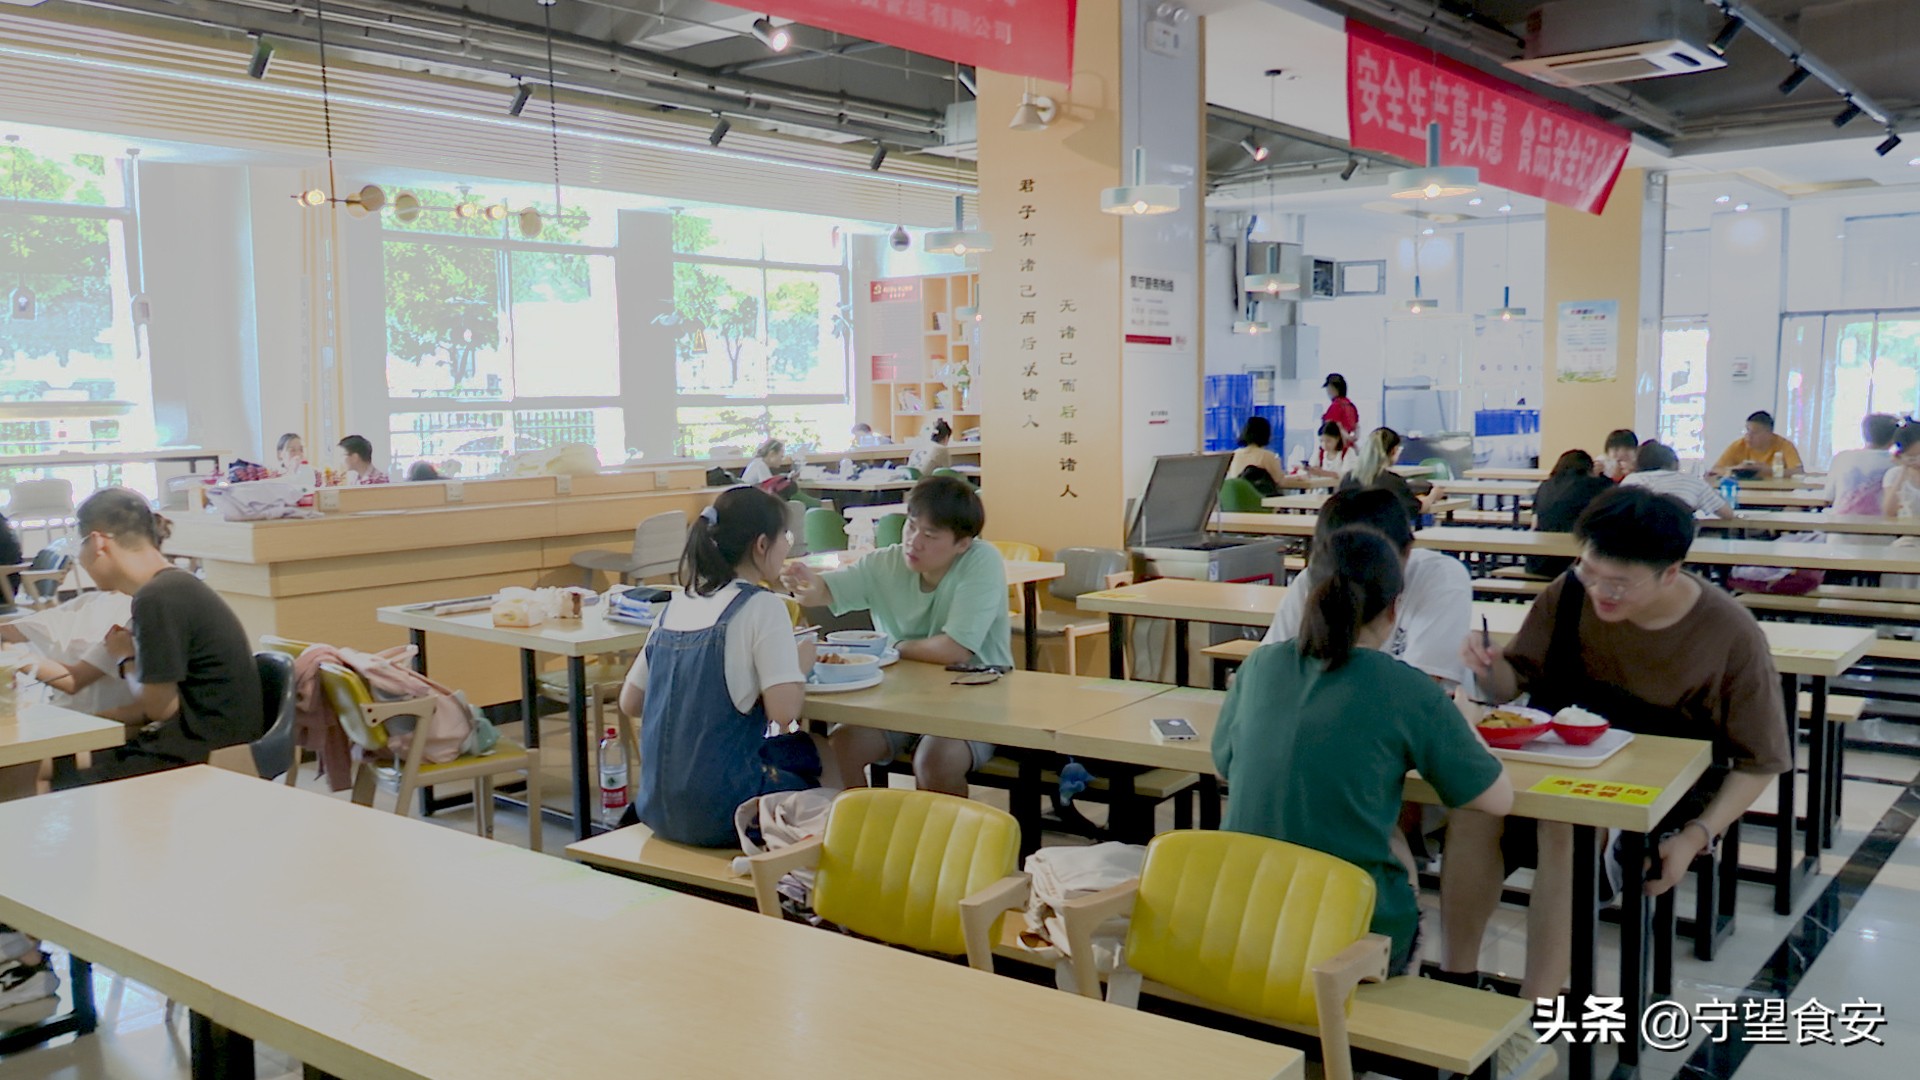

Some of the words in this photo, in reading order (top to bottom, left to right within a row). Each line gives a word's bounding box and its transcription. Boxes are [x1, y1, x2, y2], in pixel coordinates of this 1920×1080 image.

[1018, 178, 1039, 428] 君子有诸己而后求诸人
[1059, 299, 1078, 498] 无诸己而后非诸人
